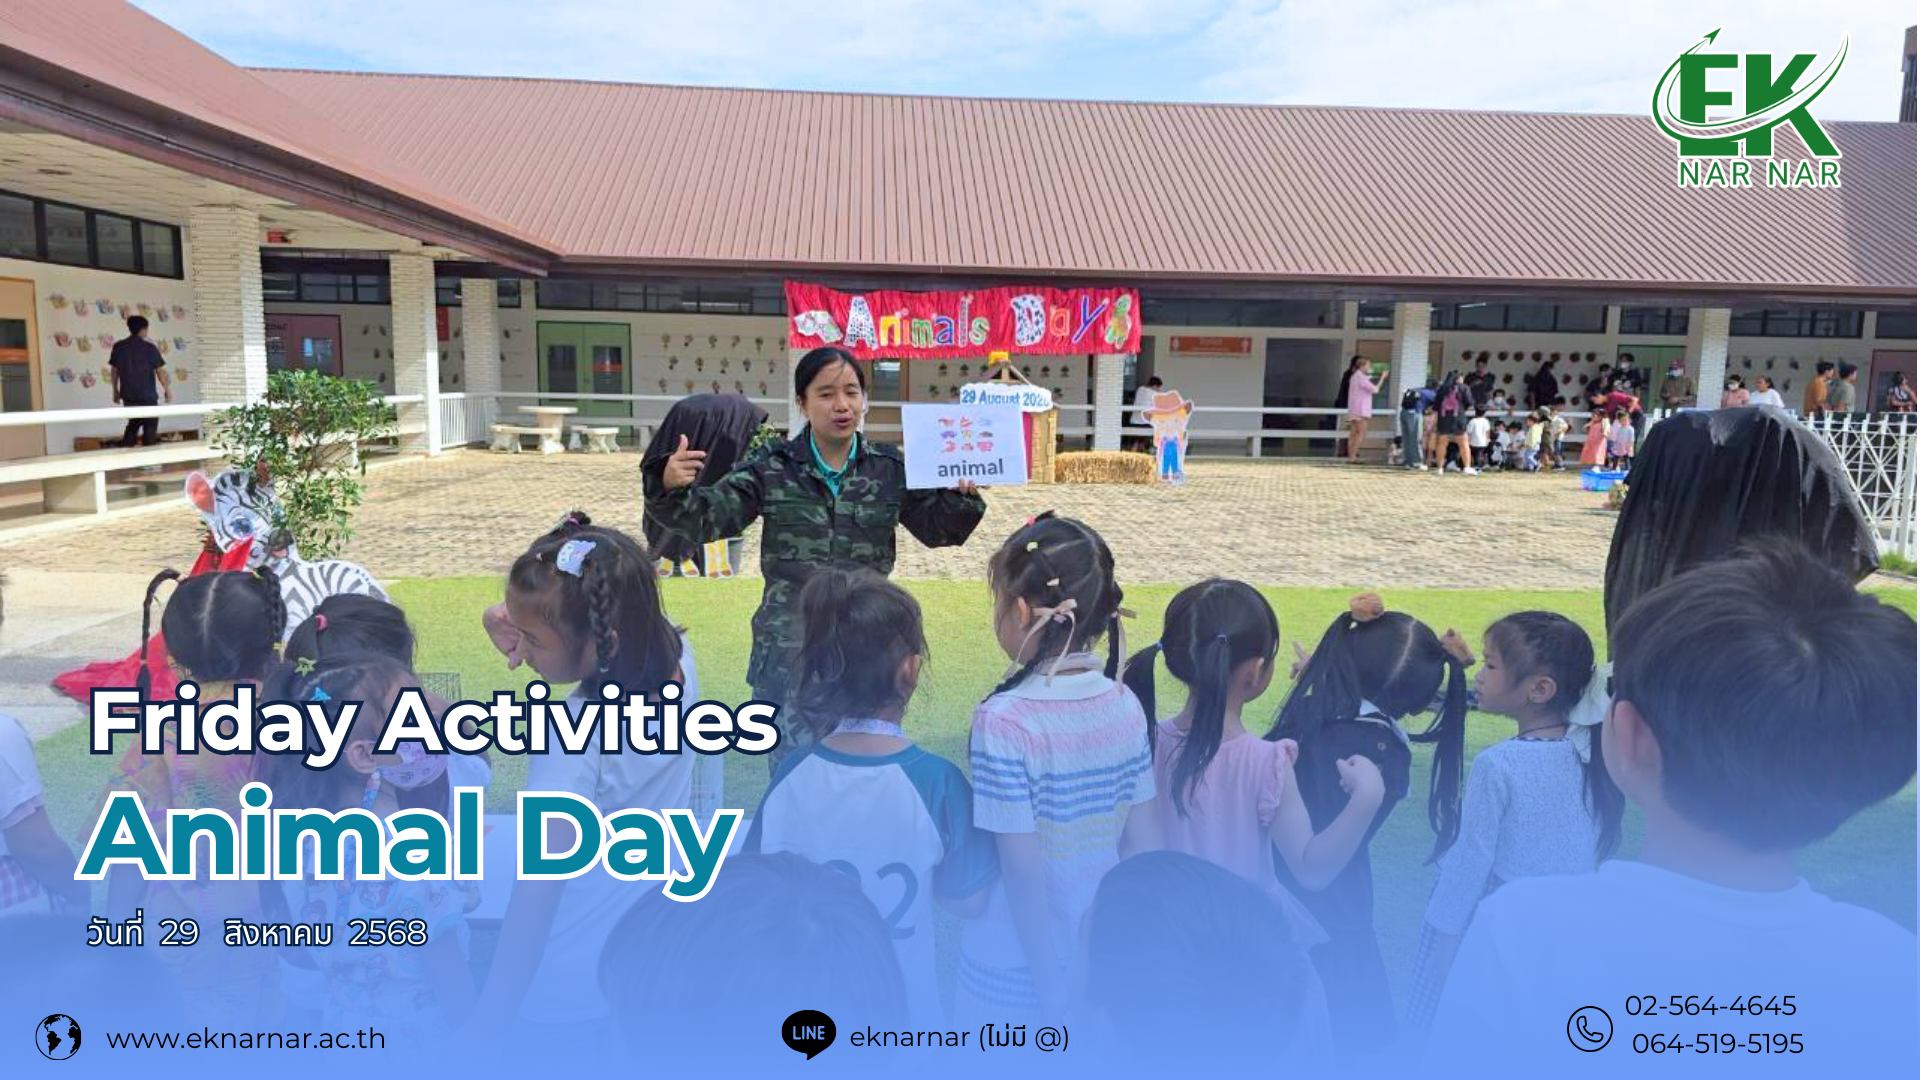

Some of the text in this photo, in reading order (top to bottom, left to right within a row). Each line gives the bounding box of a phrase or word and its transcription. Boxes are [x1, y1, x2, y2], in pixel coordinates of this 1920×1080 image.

[843, 294, 1110, 350] Animals Day
[962, 389, 976, 404] 29
[938, 458, 1004, 477] animal
